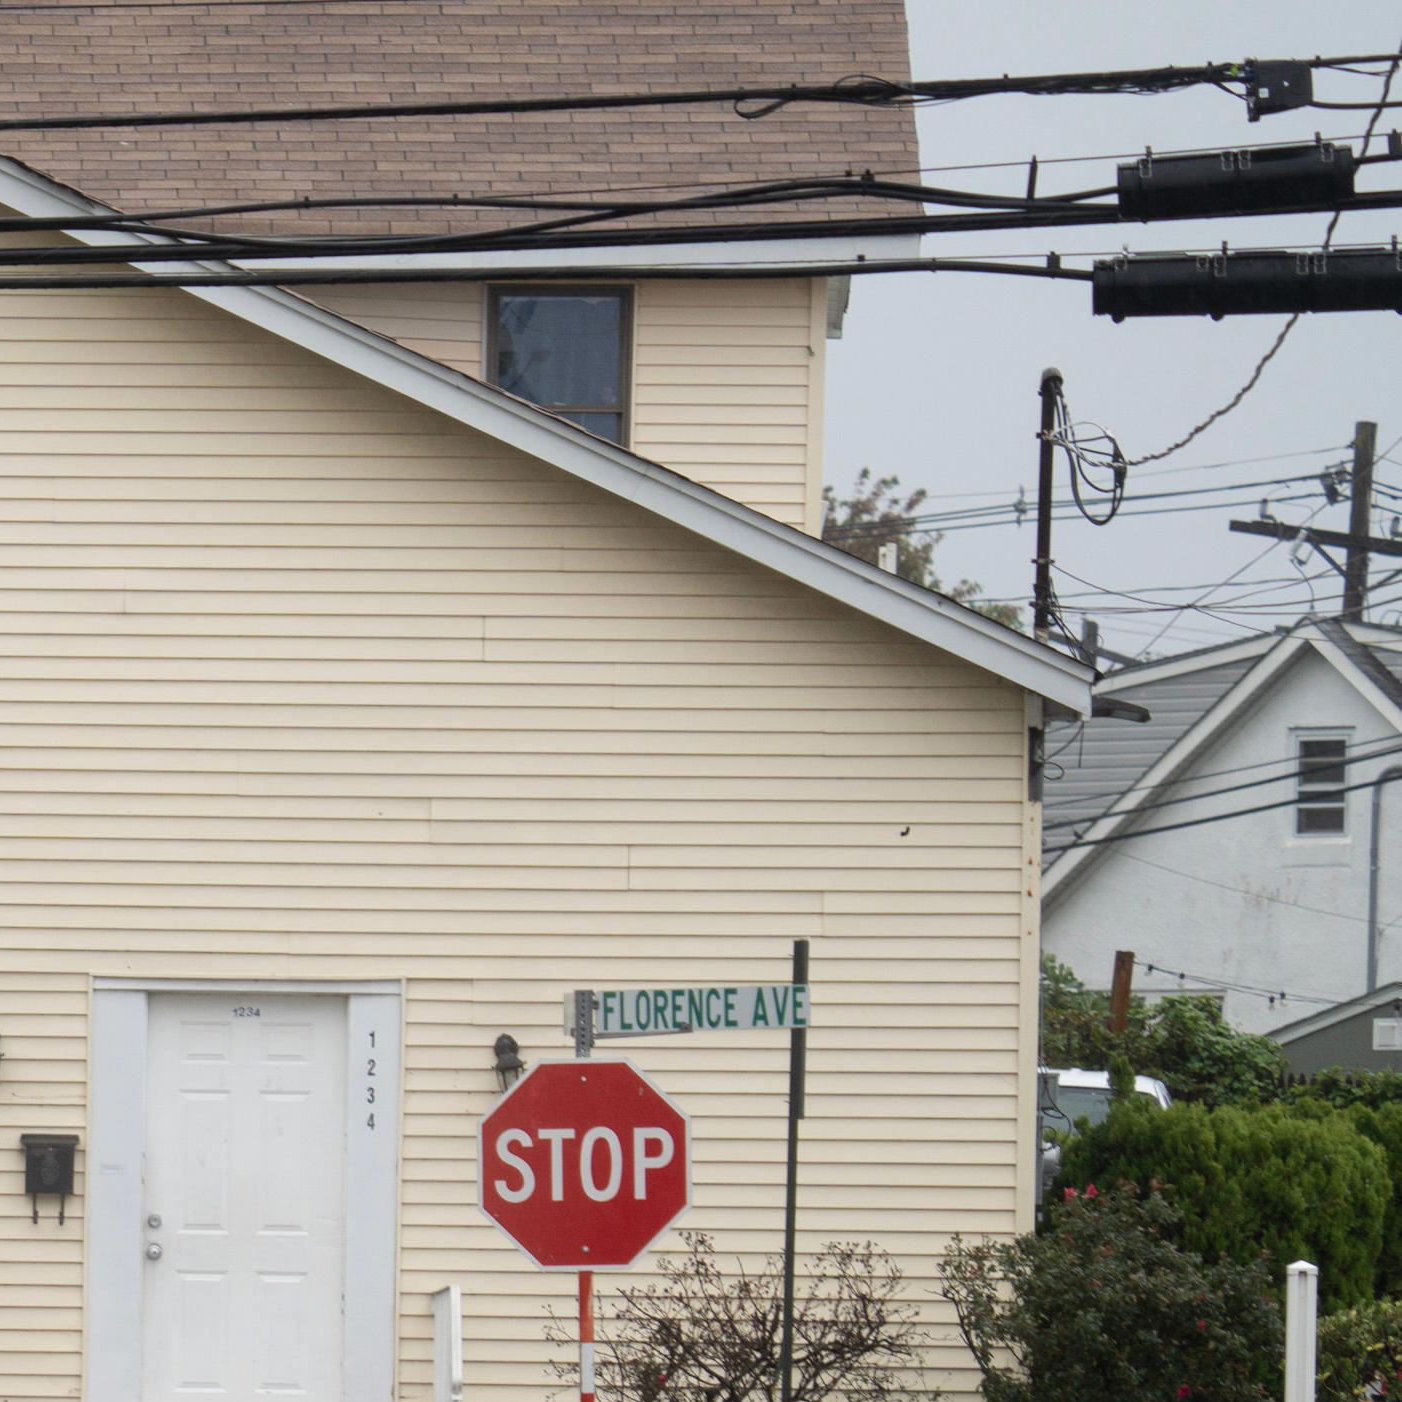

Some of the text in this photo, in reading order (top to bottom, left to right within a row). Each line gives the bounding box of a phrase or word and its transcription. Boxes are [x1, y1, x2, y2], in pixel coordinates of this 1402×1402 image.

[231, 1006, 261, 1018] 1234
[602, 986, 807, 1031] FLORENCE AVE
[494, 1125, 675, 1204] STOP
